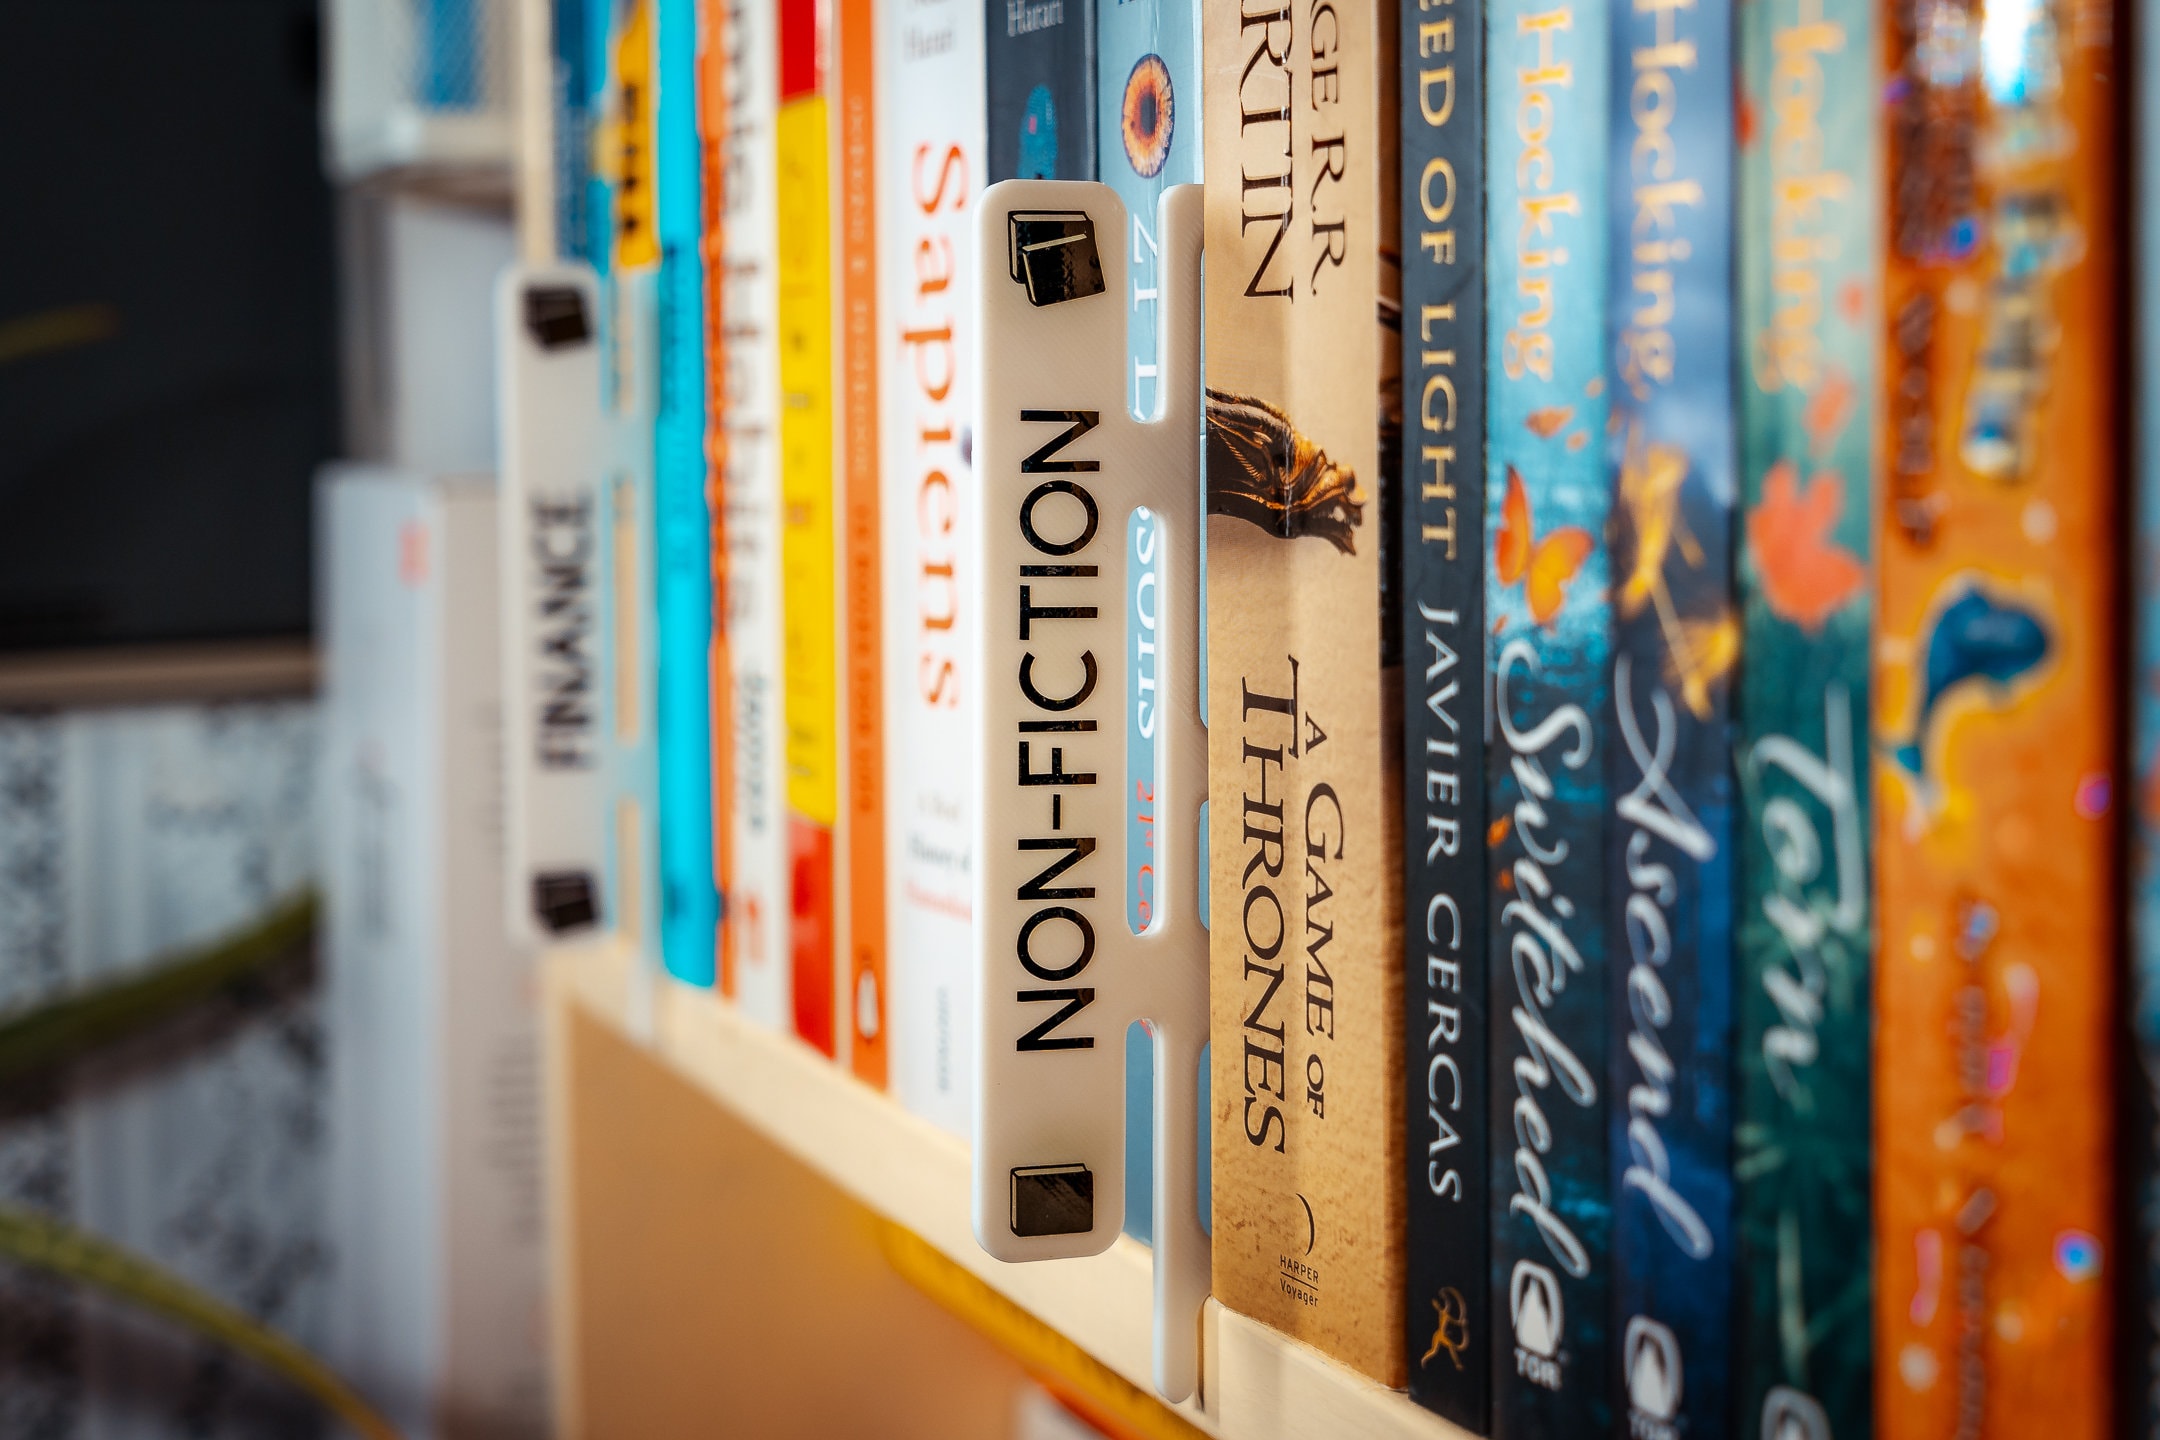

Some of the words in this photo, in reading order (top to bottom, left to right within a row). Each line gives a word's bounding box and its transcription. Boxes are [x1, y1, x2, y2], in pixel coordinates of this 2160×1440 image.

[1239, 0, 1294, 304] RTIN
[1310, 0, 1339, 111] GE
[1419, 0, 1456, 127] ED
[1420, 156, 1457, 266] OF
[1502, 8, 1581, 383] Hocking
[1615, 0, 1704, 388] Hocking
[899, 141, 970, 710] Sapiens
[1421, 303, 1457, 561] LIGHT
[531, 494, 597, 770] FINANCE
[1015, 409, 1101, 1051] NON-FICTION
[1304, 710, 1328, 755] A
[1416, 599, 1460, 867] JAVIER
[1241, 653, 1300, 1155] THRONES
[1304, 781, 1344, 1041] GAME
[1495, 638, 1597, 1280] Switched
[1613, 650, 1717, 1261] Ascend
[1746, 678, 1866, 1112] Torn
[1306, 1053, 1325, 1120] OF
[1427, 892, 1462, 1203] CERCAS
[1280, 1254, 1319, 1284] HARPER
[1280, 1277, 1319, 1307] Voyager
[1513, 1346, 1564, 1392] TOR
